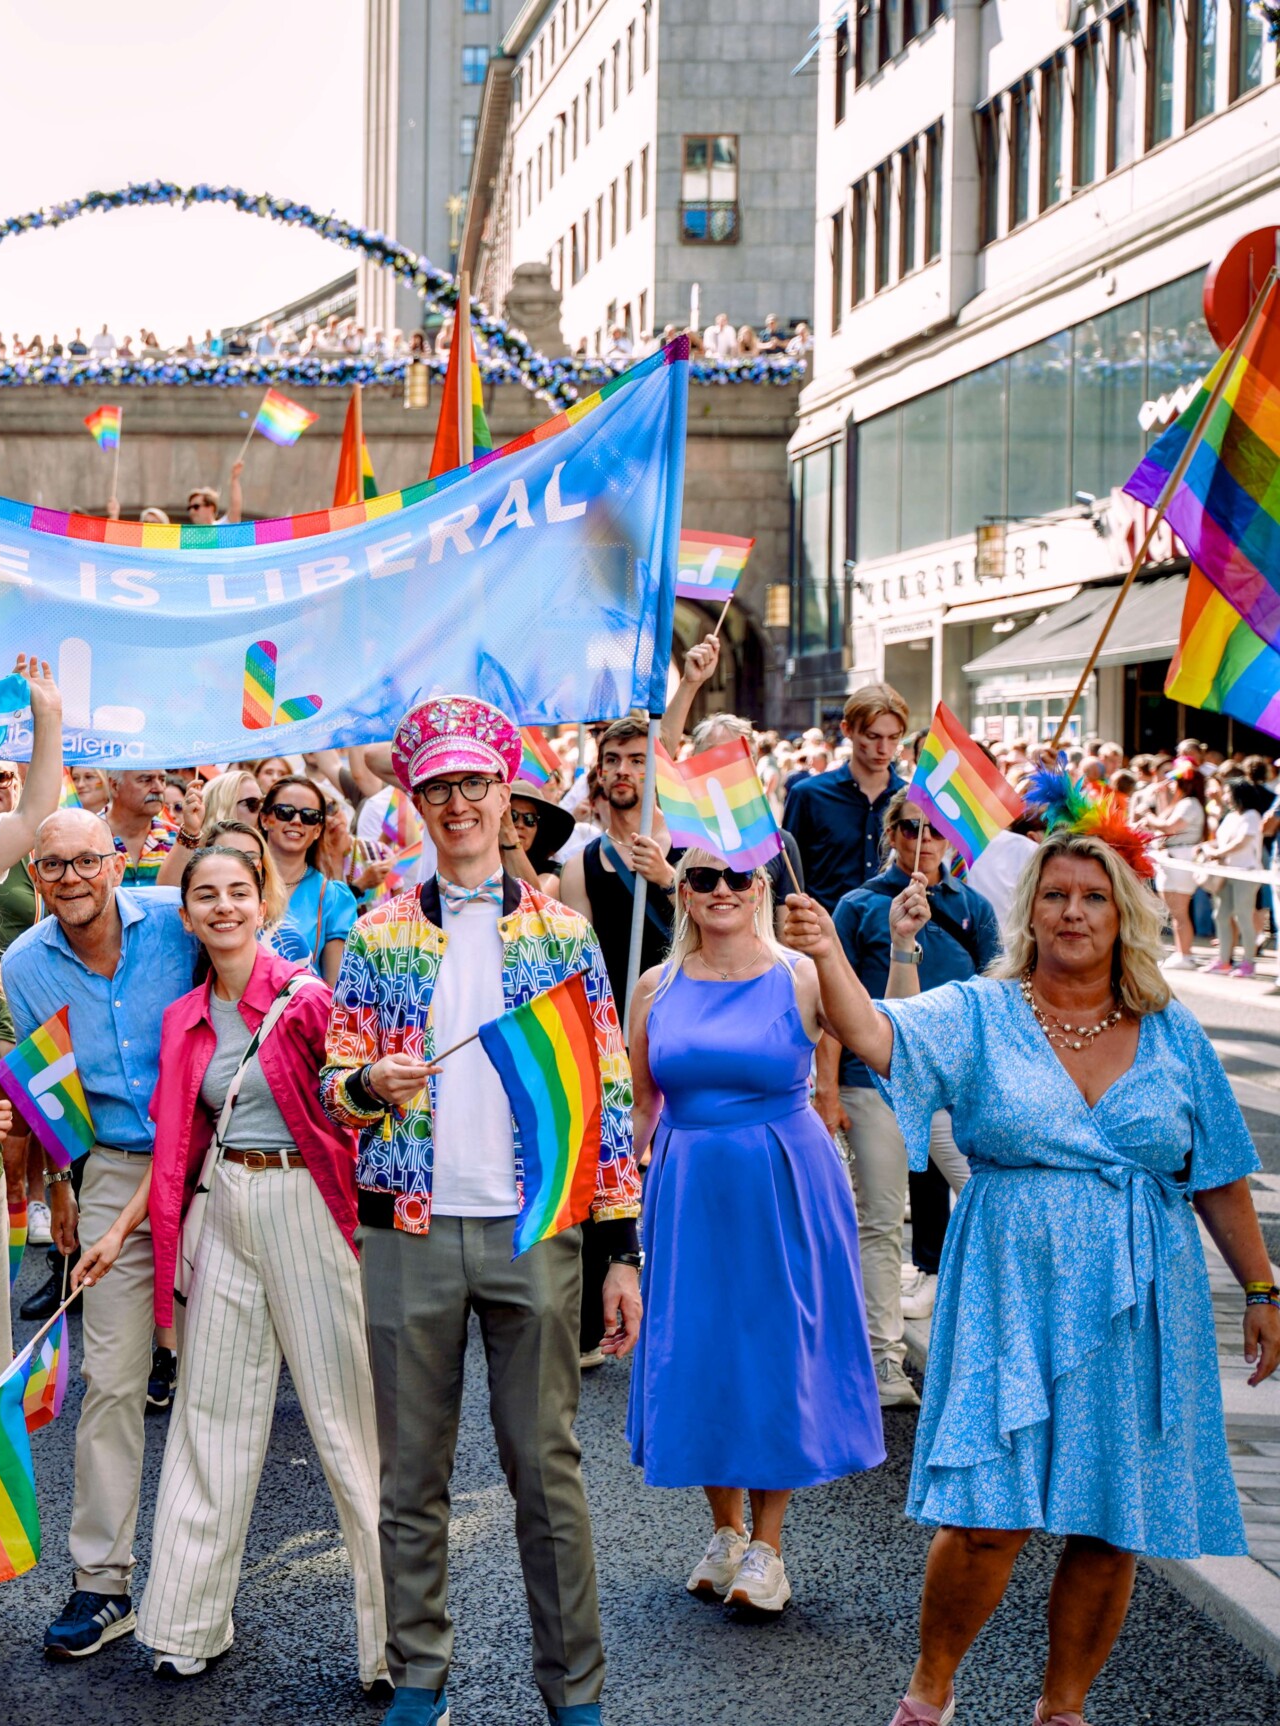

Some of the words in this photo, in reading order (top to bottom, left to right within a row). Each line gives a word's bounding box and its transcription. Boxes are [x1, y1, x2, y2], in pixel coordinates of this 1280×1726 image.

[78, 563, 160, 608] IS
[208, 461, 588, 609] LIBERAL
[4, 722, 145, 760] ibalerna
